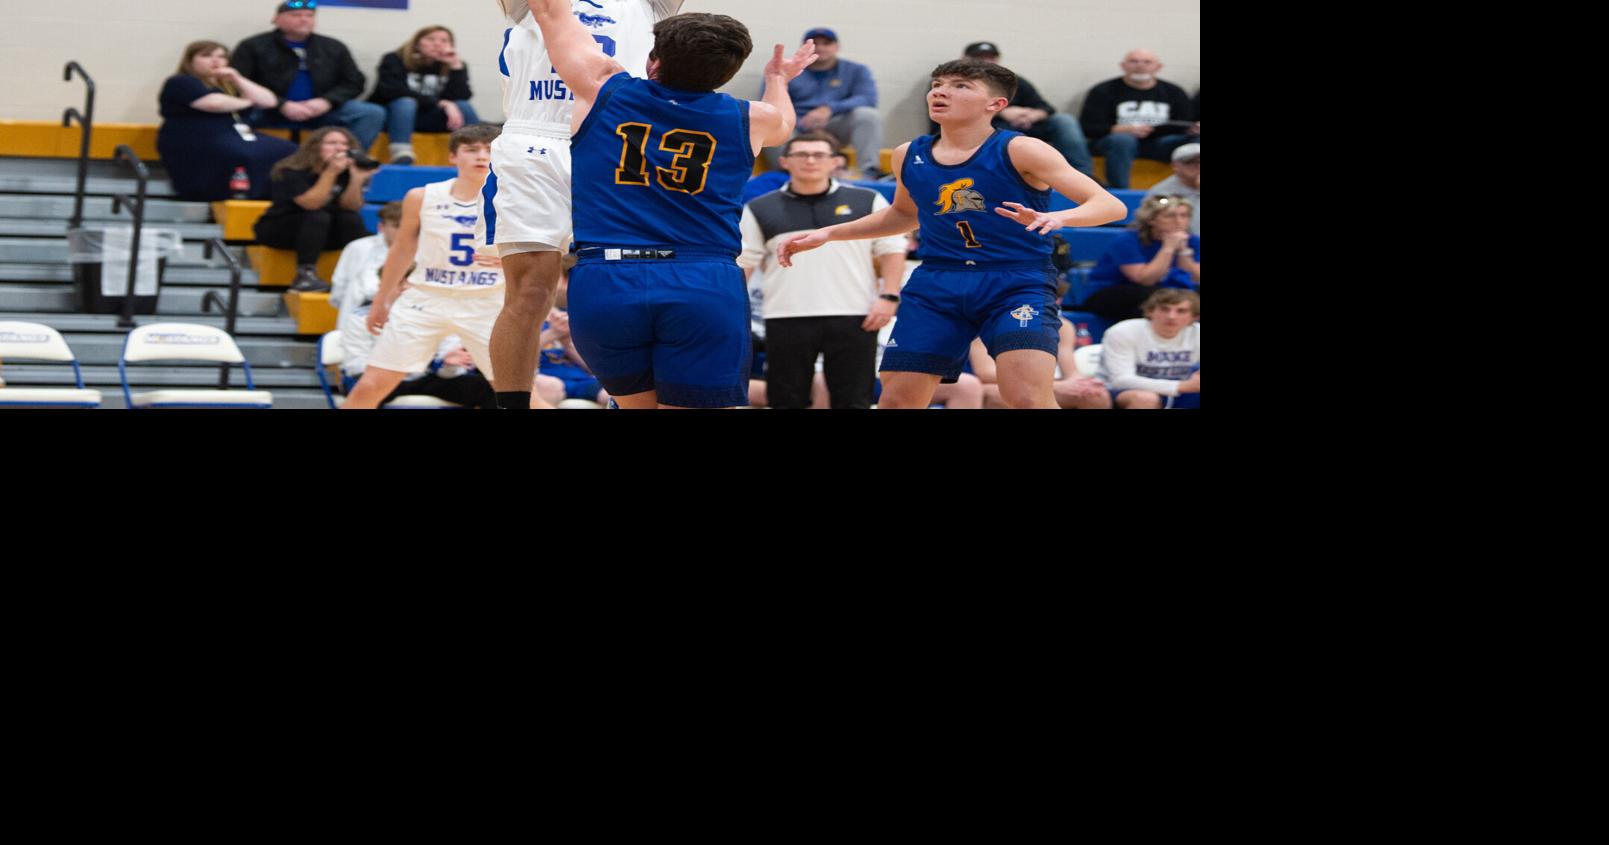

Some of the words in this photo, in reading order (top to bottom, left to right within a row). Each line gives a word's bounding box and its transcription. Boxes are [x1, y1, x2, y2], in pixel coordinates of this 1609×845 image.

[615, 121, 717, 195] 13
[449, 232, 475, 267] 5
[956, 220, 982, 248] 1
[425, 267, 498, 285] MUSTANGS
